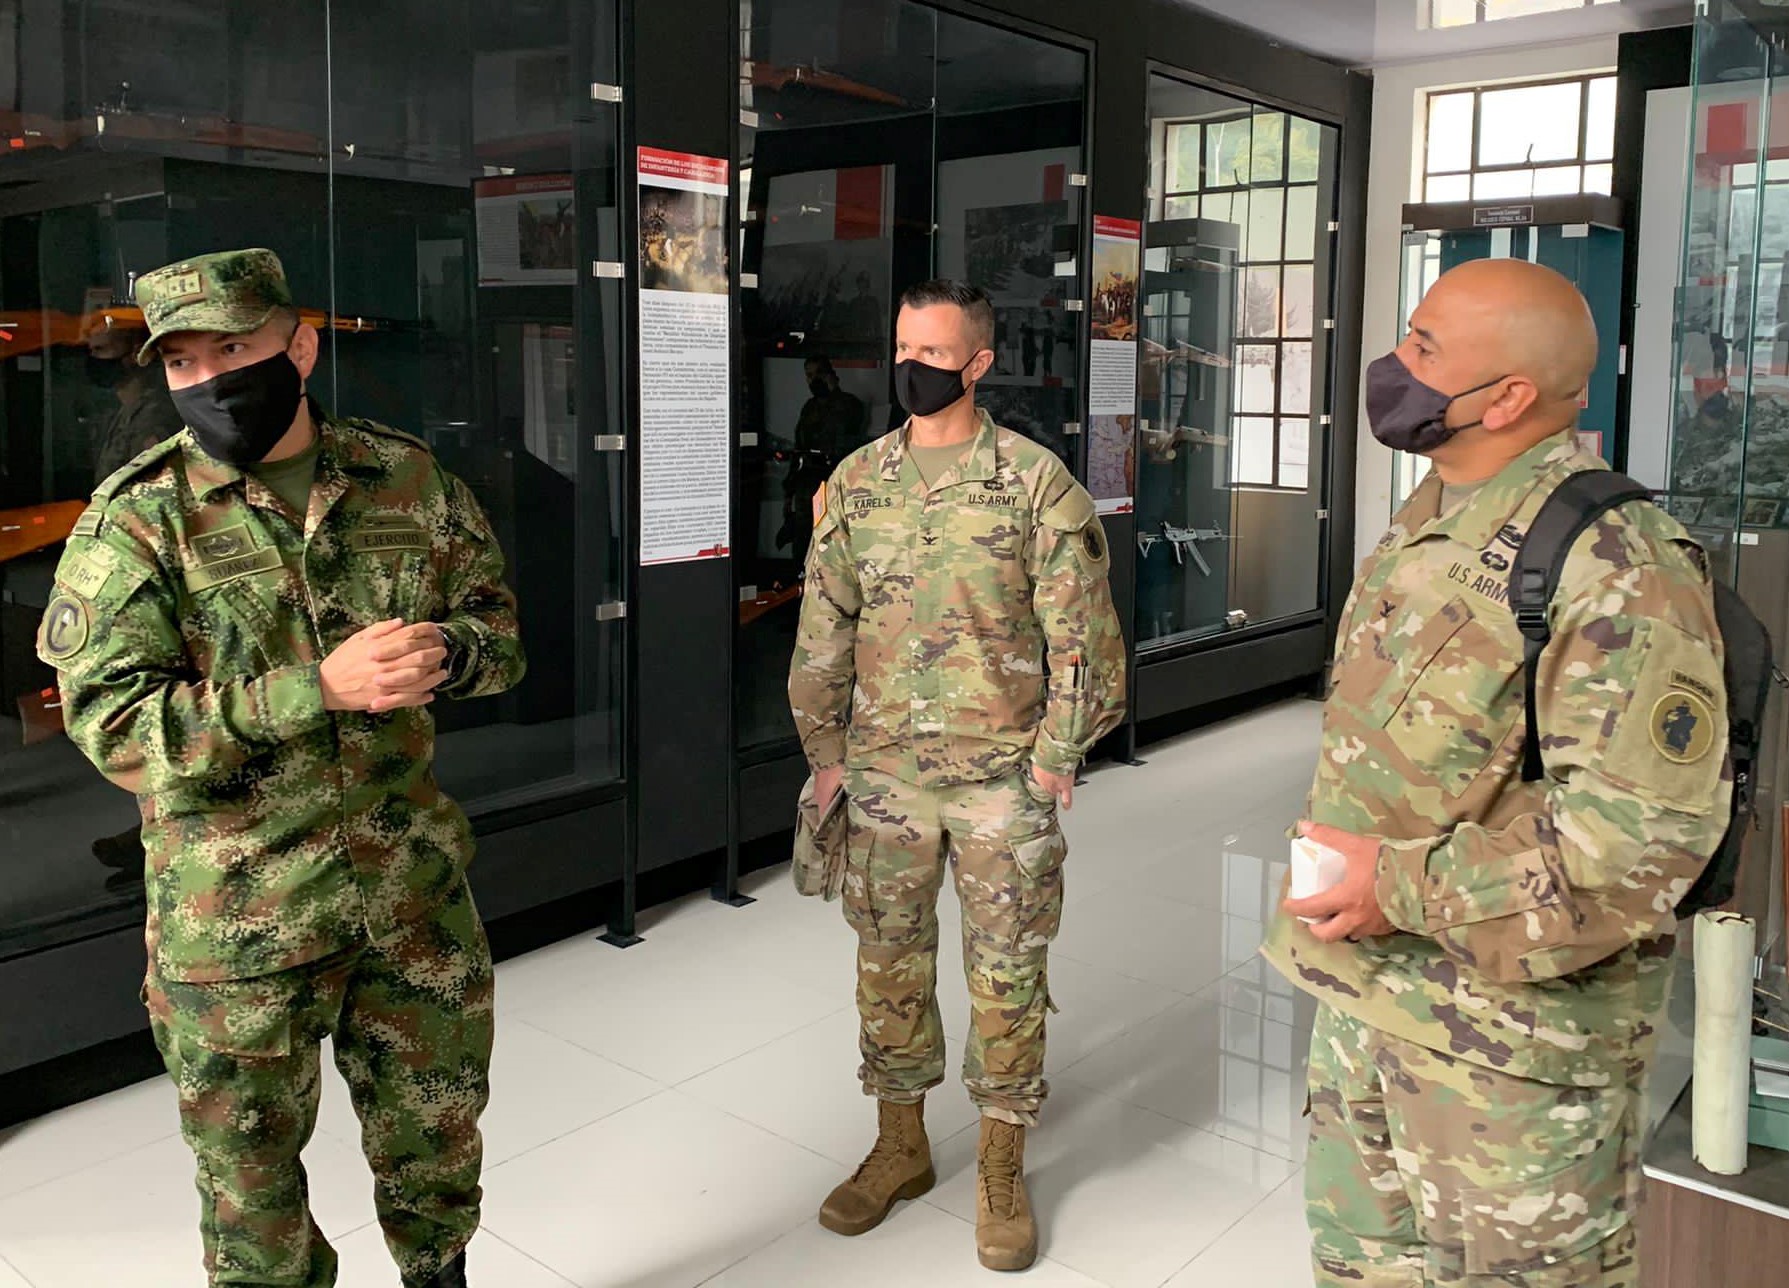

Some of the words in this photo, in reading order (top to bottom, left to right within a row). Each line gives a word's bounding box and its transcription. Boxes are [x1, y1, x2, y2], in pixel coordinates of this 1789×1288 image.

[853, 496, 892, 510] KARELS
[987, 495, 1017, 506] ARMY
[1447, 562, 1471, 587] U.S.
[1470, 574, 1509, 603] ARM
